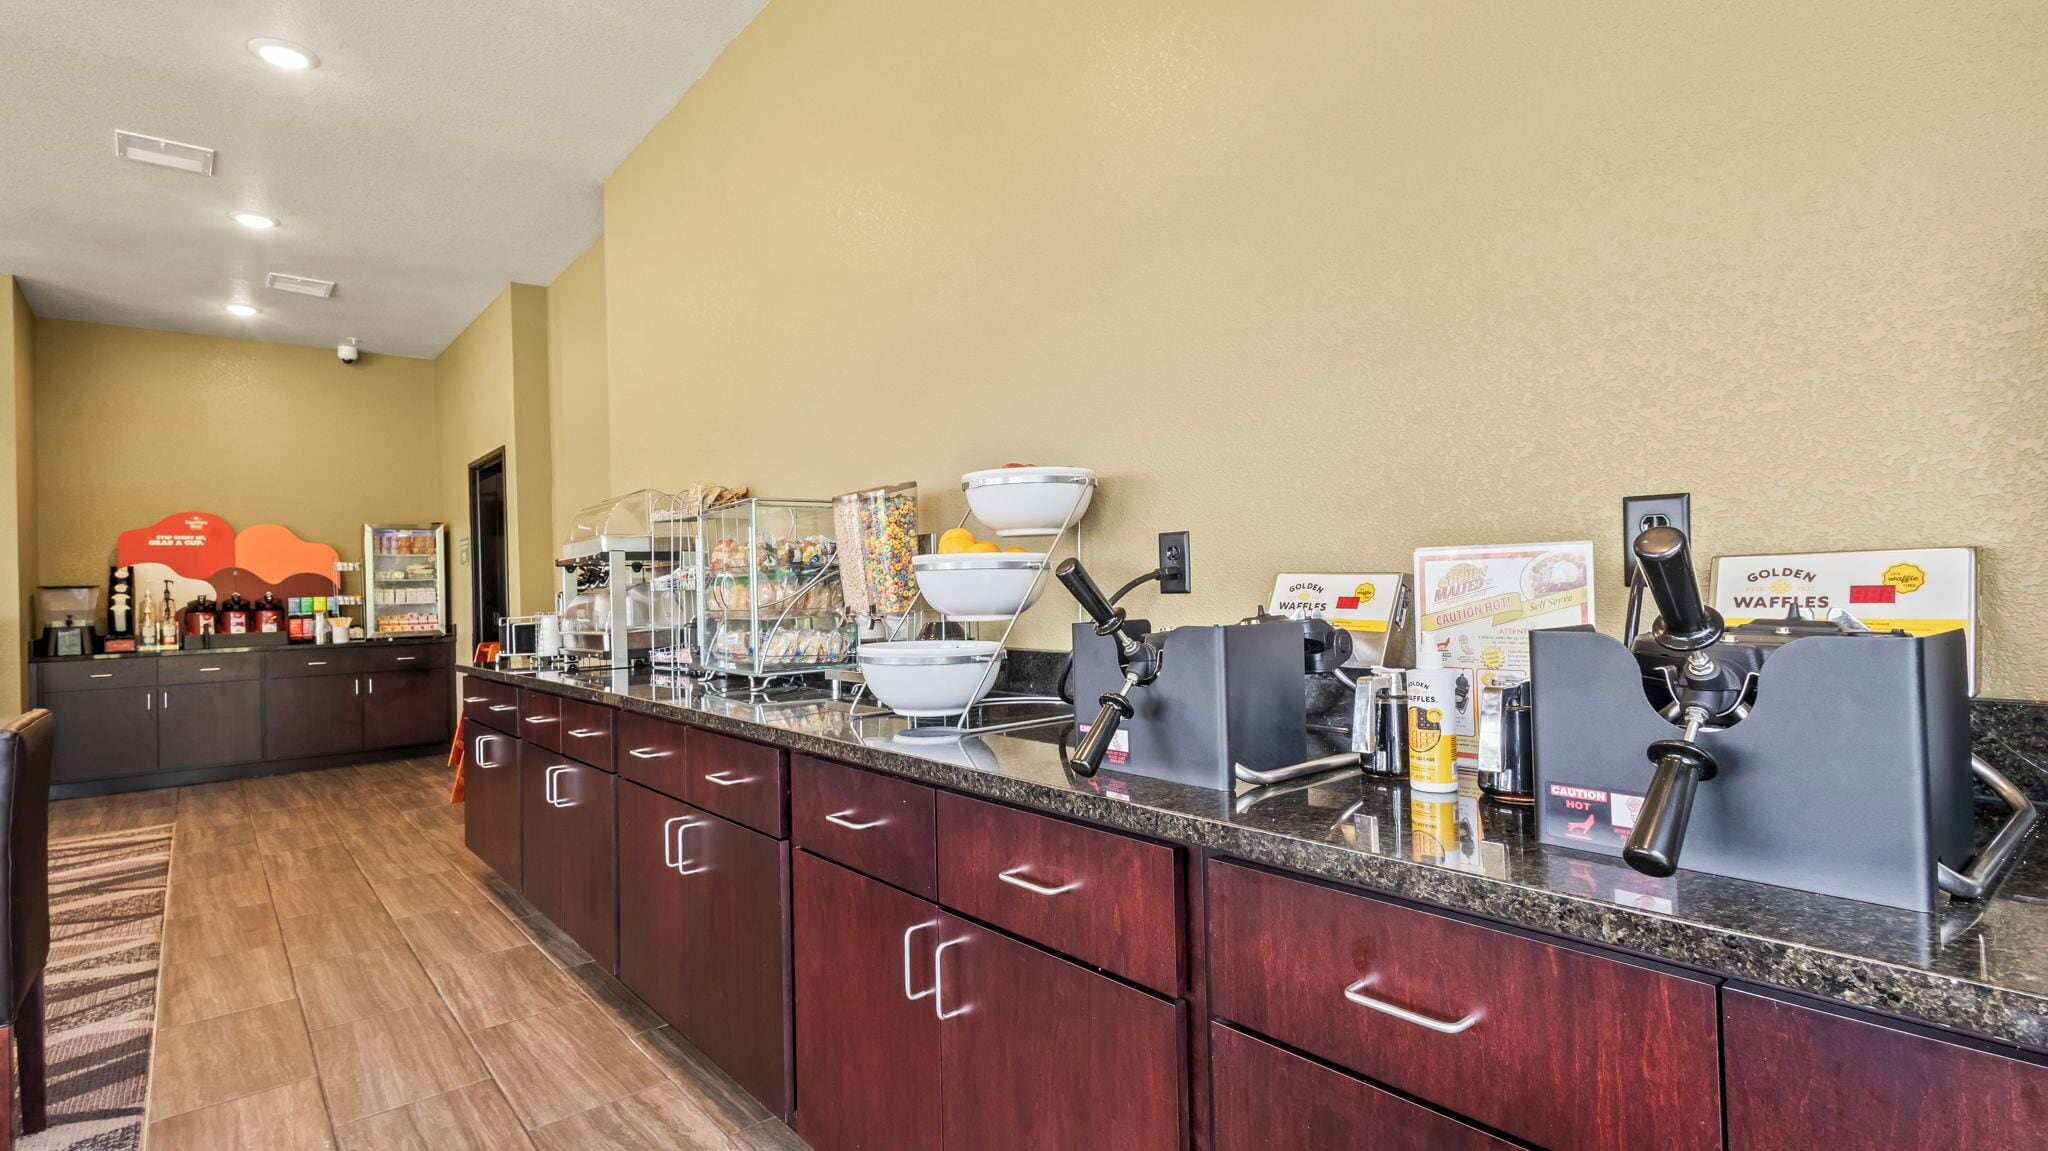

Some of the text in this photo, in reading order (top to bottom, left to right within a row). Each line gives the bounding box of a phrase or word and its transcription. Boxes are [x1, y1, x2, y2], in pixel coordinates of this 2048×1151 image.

[1746, 567, 1817, 583] GOLDEN
[1888, 574, 1919, 584] waffle
[1289, 582, 1324, 594] GOLDEN
[1434, 577, 1485, 603] MALTED
[1279, 601, 1328, 611] WAFFLES
[1530, 594, 1574, 612] Self Serve
[1733, 595, 1830, 609] WAFFLES
[1436, 596, 1512, 626] CAUTION HOT!
[1407, 695, 1436, 703] AFFLES
[1551, 785, 1606, 801] CAUTION
[1566, 800, 1591, 811] HOT
